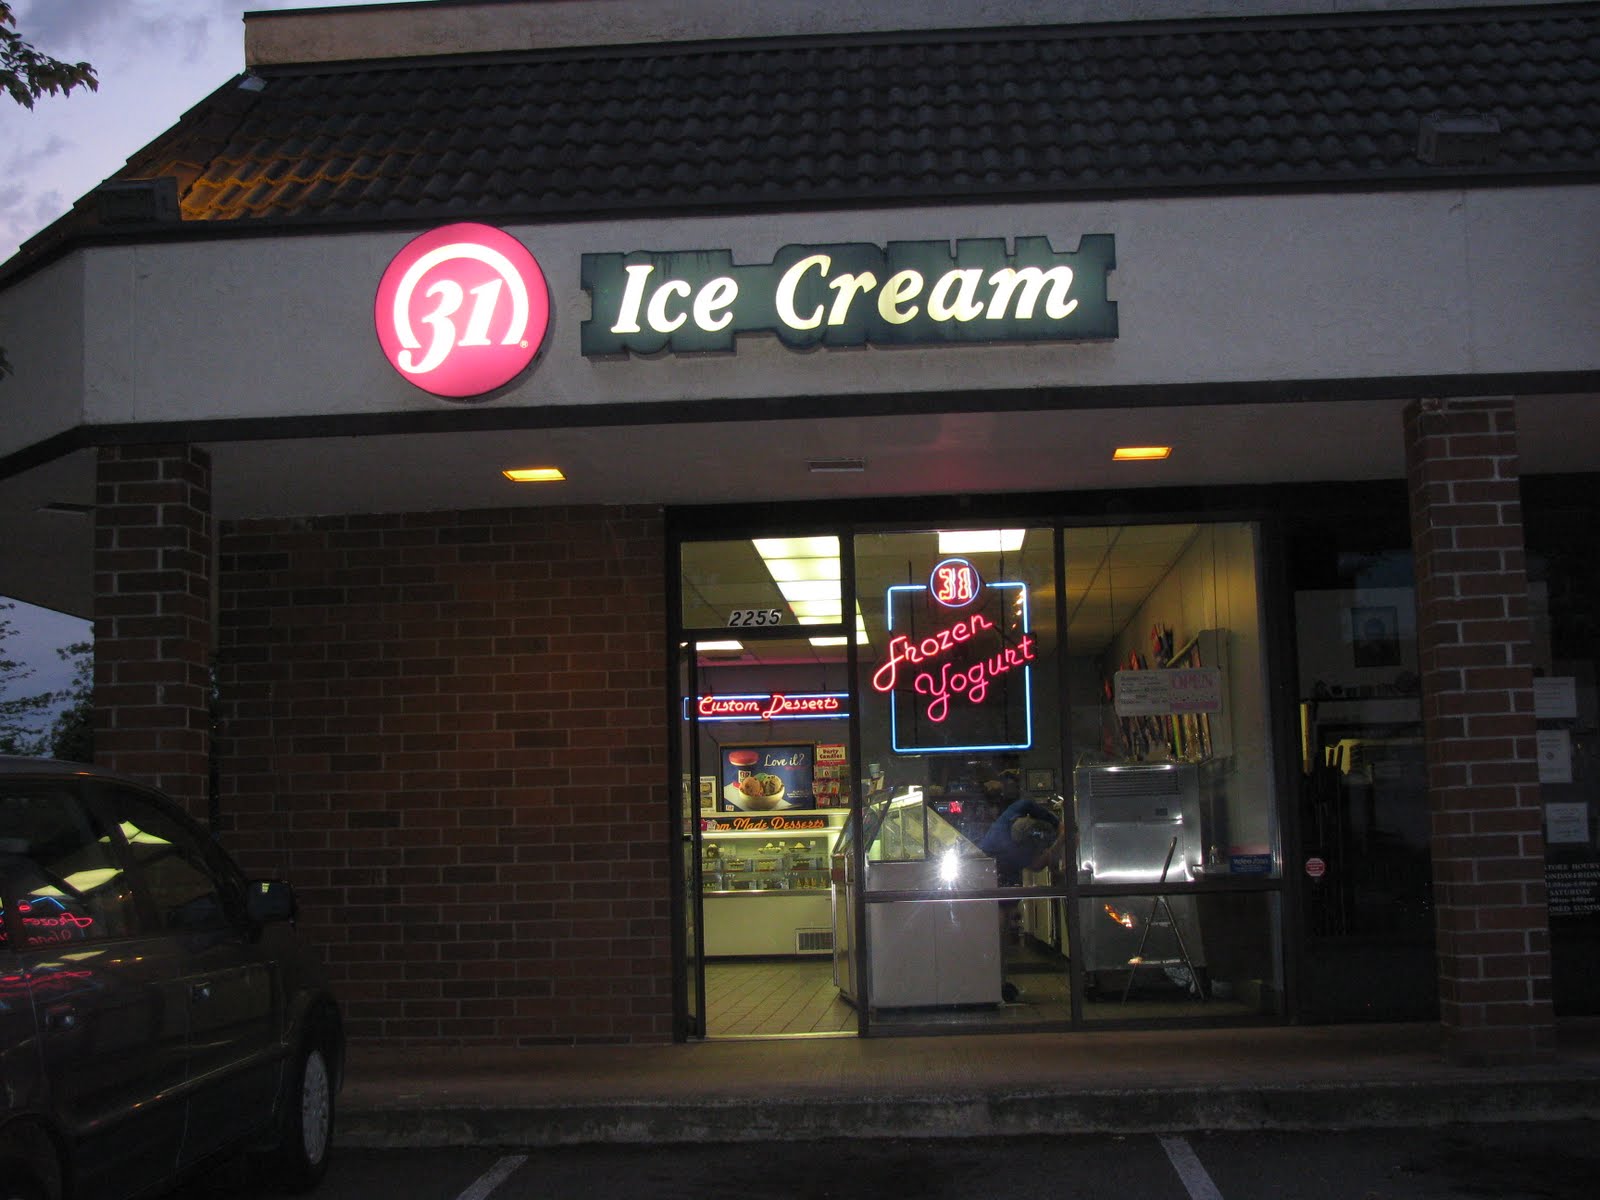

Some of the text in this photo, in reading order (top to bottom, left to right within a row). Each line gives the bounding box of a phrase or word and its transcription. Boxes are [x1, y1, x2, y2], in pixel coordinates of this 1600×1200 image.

[611, 254, 1079, 334] Ice Cream
[399, 278, 503, 374] 31
[729, 610, 781, 626] 2255
[873, 614, 992, 691] Frozen
[915, 635, 1035, 722] Yogurt
[700, 695, 839, 718] Custom Desserts
[763, 753, 804, 767] Love it?
[733, 817, 769, 831] Made
[771, 816, 825, 830] Desserts
